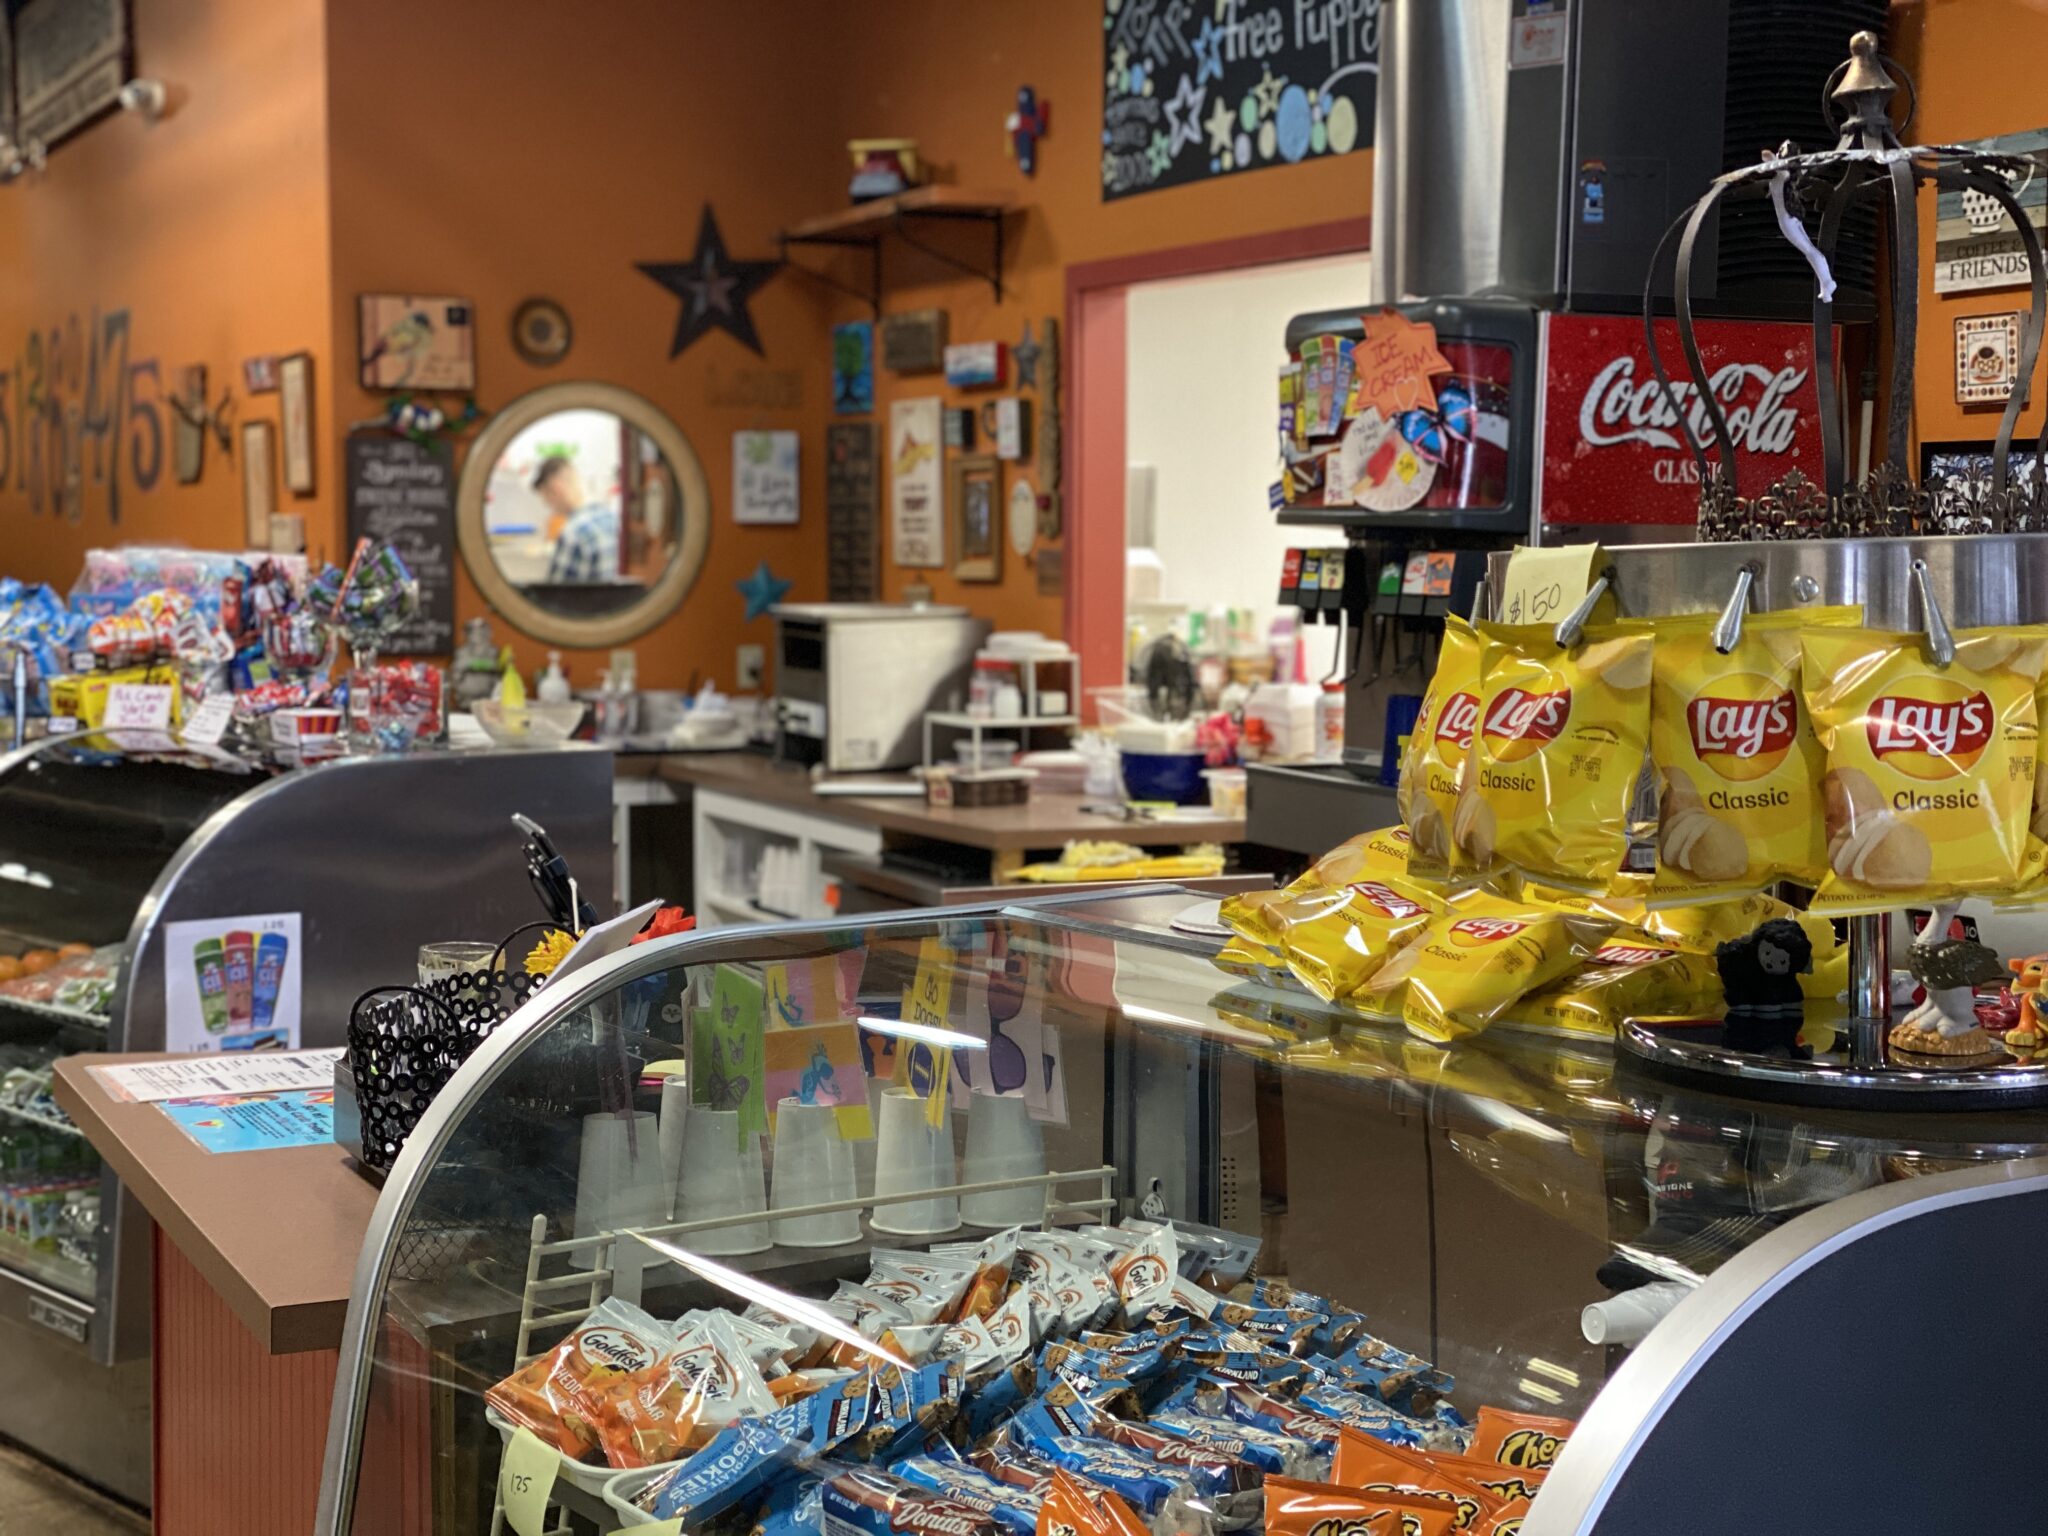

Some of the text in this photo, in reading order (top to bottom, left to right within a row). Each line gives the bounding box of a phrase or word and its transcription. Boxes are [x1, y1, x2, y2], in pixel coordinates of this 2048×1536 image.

[1949, 254, 2028, 281] FRIENDS
[1371, 333, 1404, 369] ICE
[1371, 345, 1434, 398] CREAM
[1486, 690, 1566, 741] Lay's
[1697, 695, 1791, 758] Lay's
[1876, 697, 1985, 756] Lay's
[1480, 770, 1536, 793] Classic
[1709, 788, 1789, 810] Classic
[1893, 789, 1979, 811] Classic
[583, 1333, 646, 1372] Goldfish
[893, 1502, 975, 1535] Donuts
